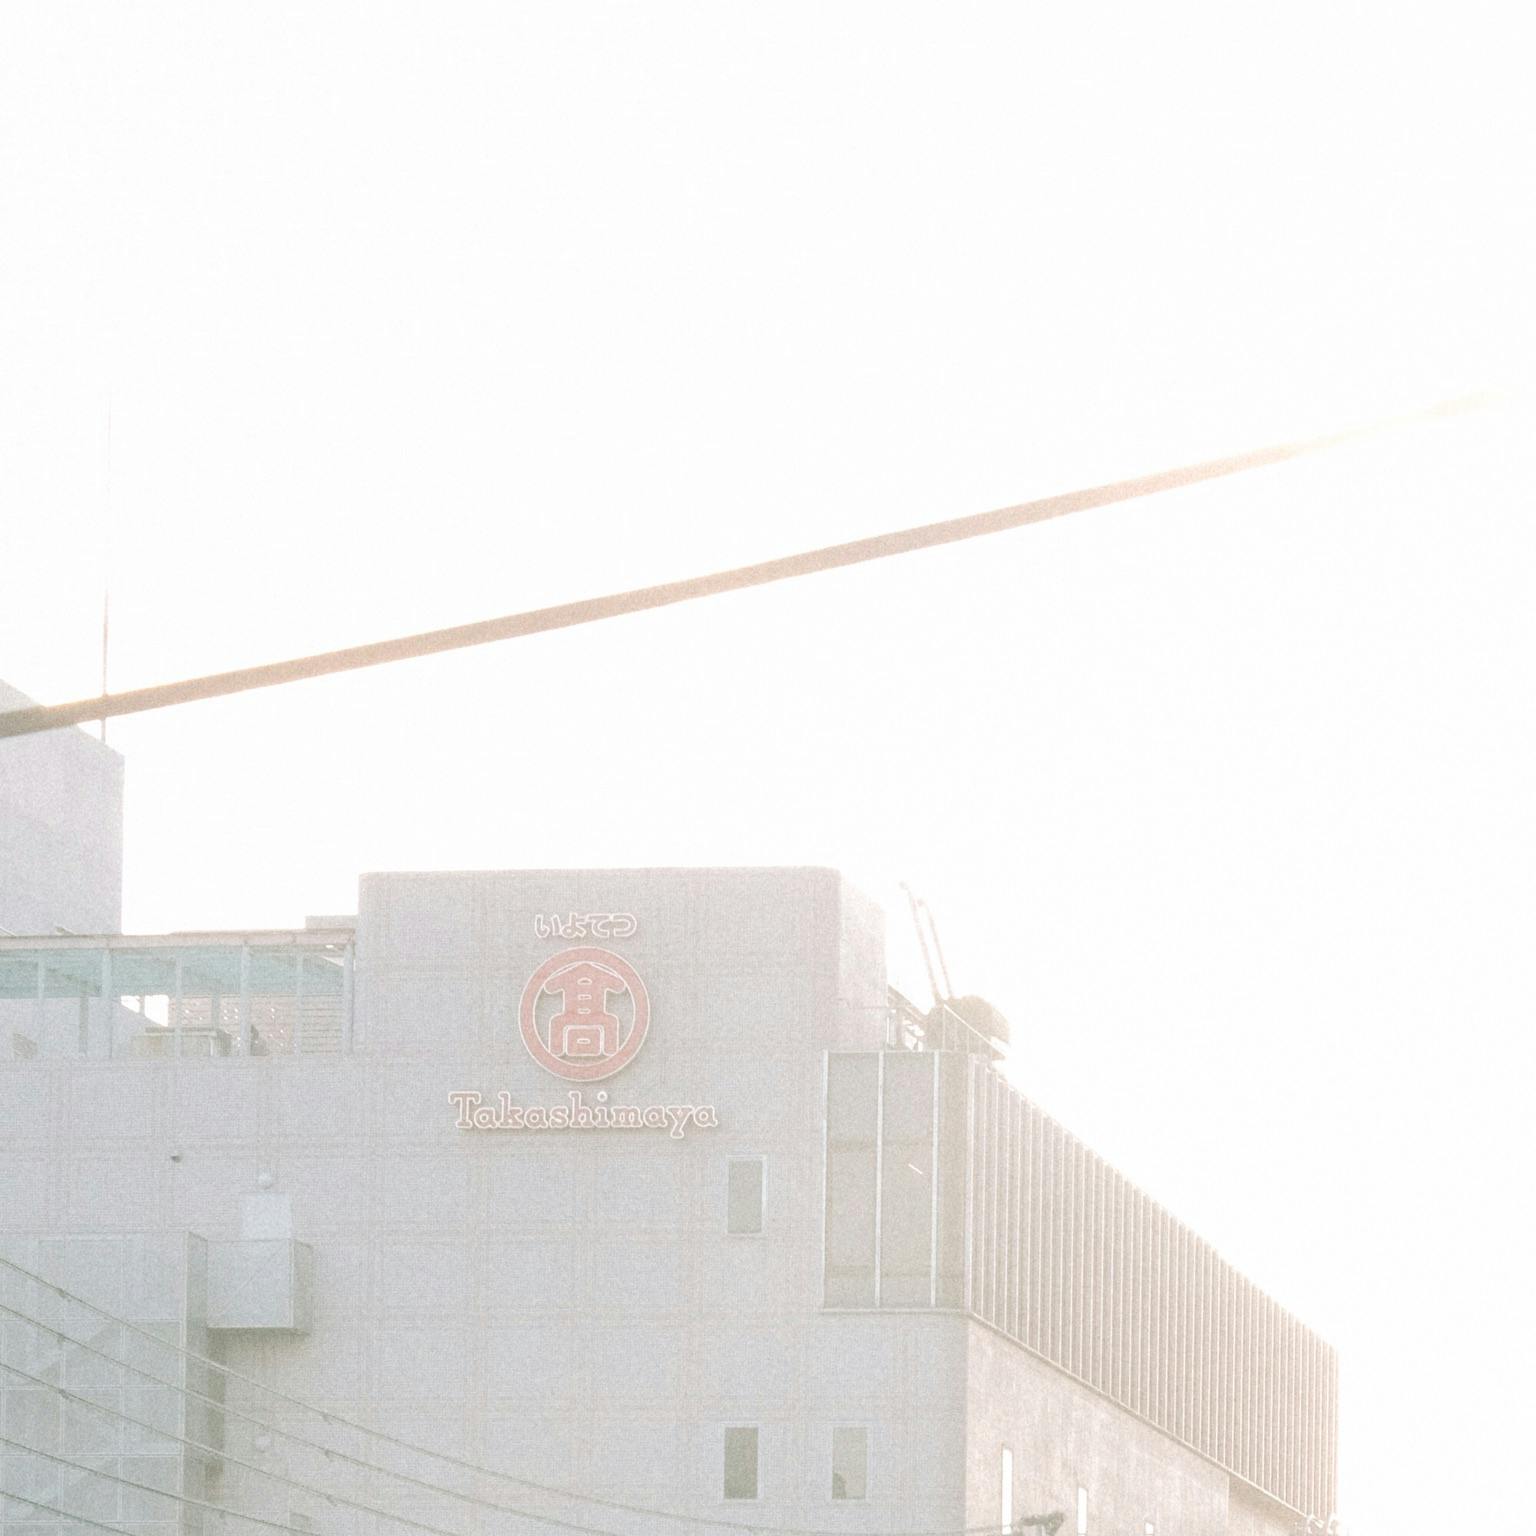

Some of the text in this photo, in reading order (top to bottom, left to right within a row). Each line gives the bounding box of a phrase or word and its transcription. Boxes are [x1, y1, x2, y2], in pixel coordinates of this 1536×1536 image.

[534, 913, 637, 938] いよてつ
[449, 1091, 718, 1138] Takashimaya
